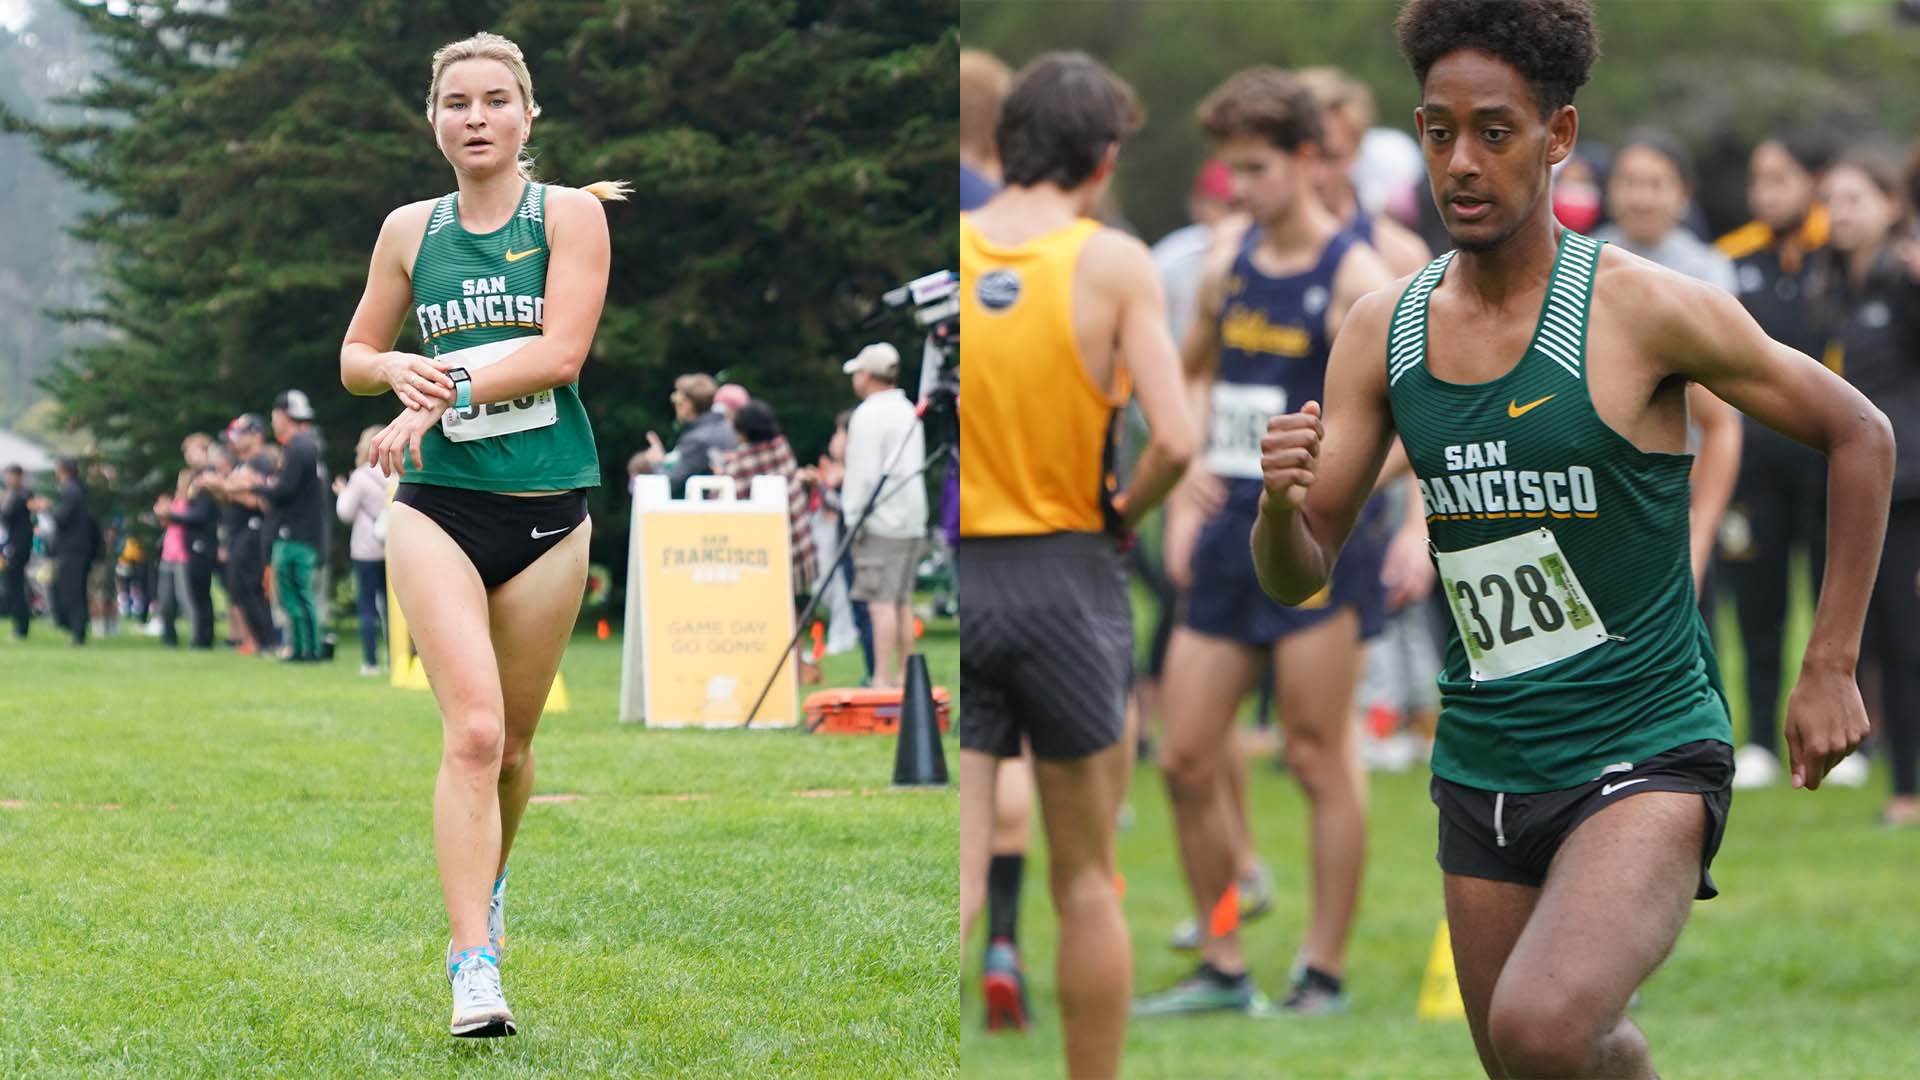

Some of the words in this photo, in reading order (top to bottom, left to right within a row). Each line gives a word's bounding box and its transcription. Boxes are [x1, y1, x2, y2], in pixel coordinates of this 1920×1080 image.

[462, 276, 505, 296] SAN
[416, 295, 544, 339] FRANCISC
[1444, 440, 1507, 470] SAN
[1417, 465, 1597, 518] RANCISCO
[662, 546, 768, 568] FRANCISCO
[1456, 564, 1565, 651] 328
[668, 620, 722, 635] GAME
[730, 620, 767, 635] DAY
